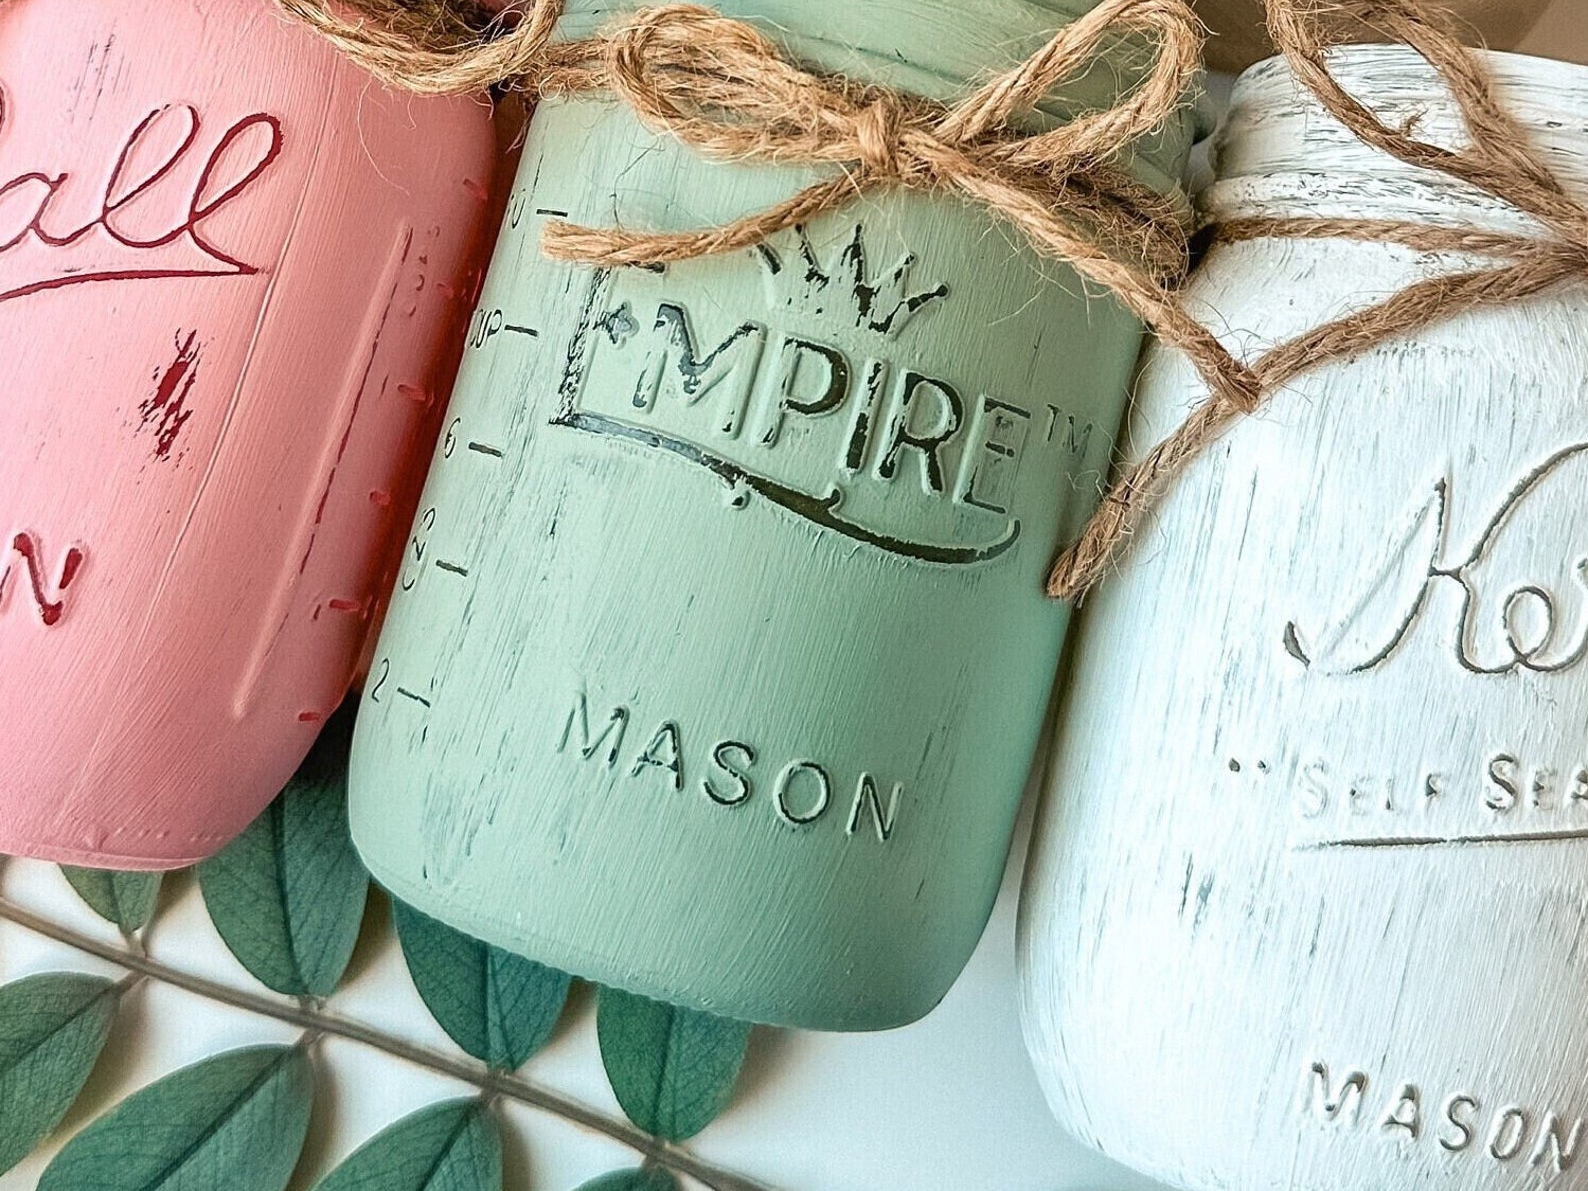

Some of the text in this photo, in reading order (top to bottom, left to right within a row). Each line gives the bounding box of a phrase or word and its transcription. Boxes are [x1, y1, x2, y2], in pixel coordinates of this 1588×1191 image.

[0, 85, 284, 275] all
[549, 257, 1032, 516] EMPIRE
[1283, 442, 1588, 676] Ke
[556, 692, 903, 841] MASON
[1303, 1060, 1584, 1173] MASON
